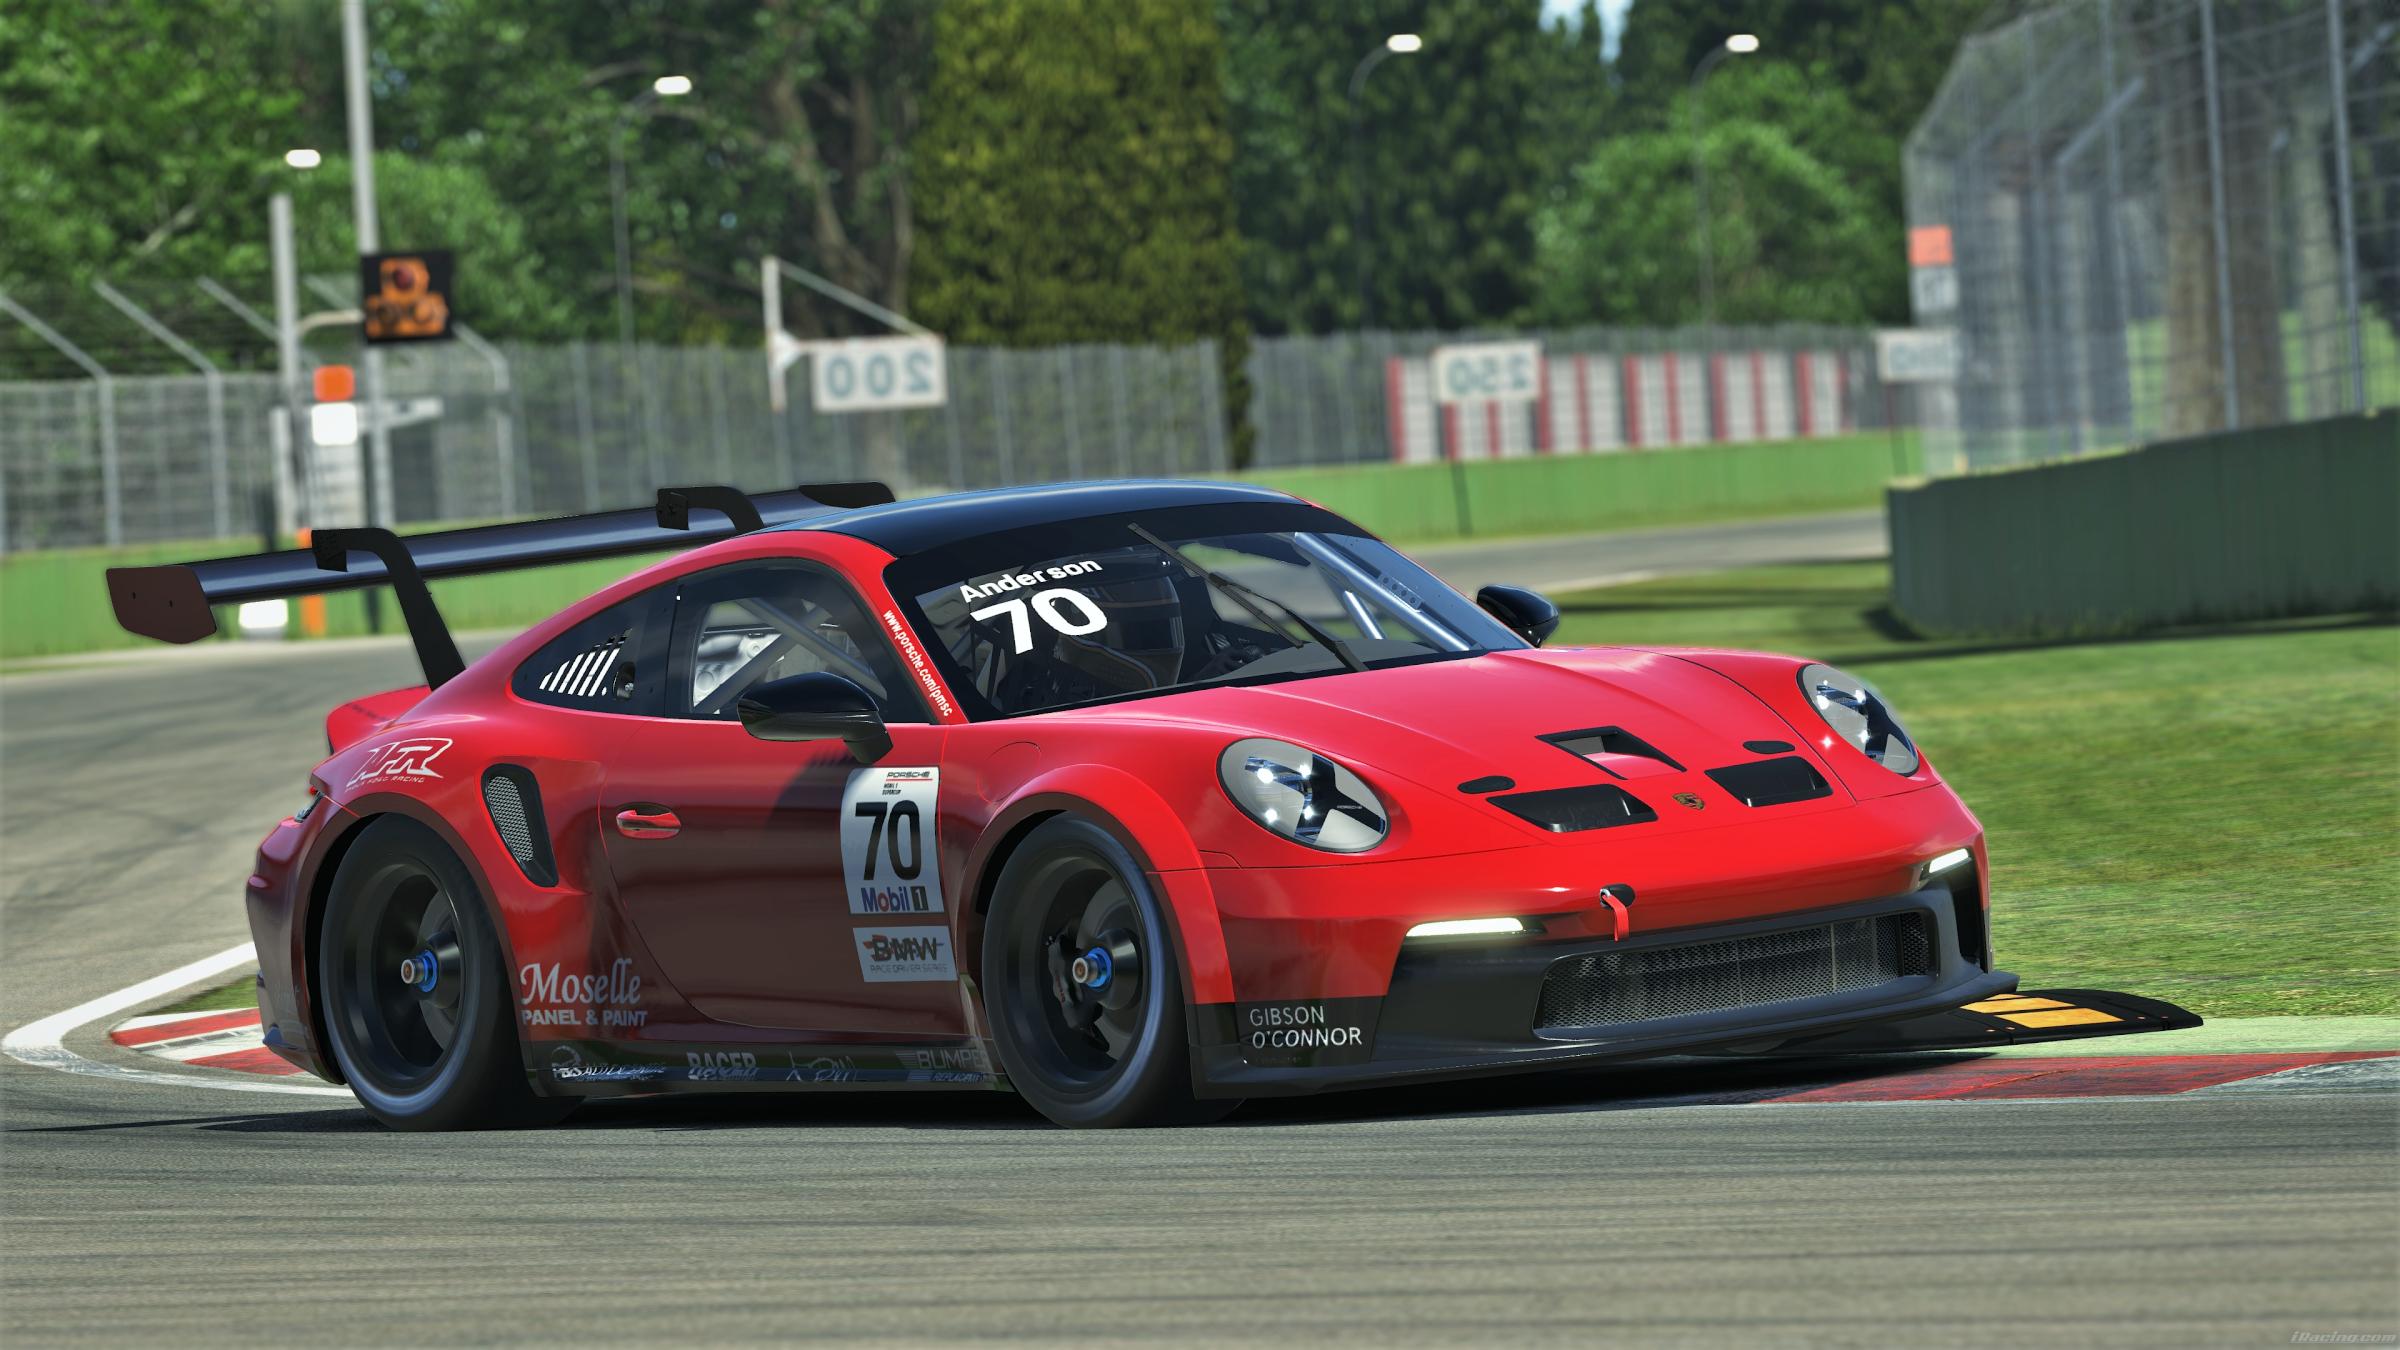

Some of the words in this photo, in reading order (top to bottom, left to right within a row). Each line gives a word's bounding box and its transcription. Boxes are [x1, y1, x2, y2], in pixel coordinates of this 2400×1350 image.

[960, 560, 1103, 603] Anderson
[969, 588, 1108, 655] 70
[883, 610, 952, 717] www.porsche.com/pmsc
[855, 799, 923, 882] 70
[861, 886, 911, 912] Mobil
[519, 958, 642, 1006] Moselle
[520, 1009, 582, 1026] PANEL
[585, 1009, 599, 1025] &
[602, 1010, 648, 1027] PAINT
[1249, 1005, 1325, 1026] GIBSON
[1252, 1027, 1363, 1049] O'CONNOR
